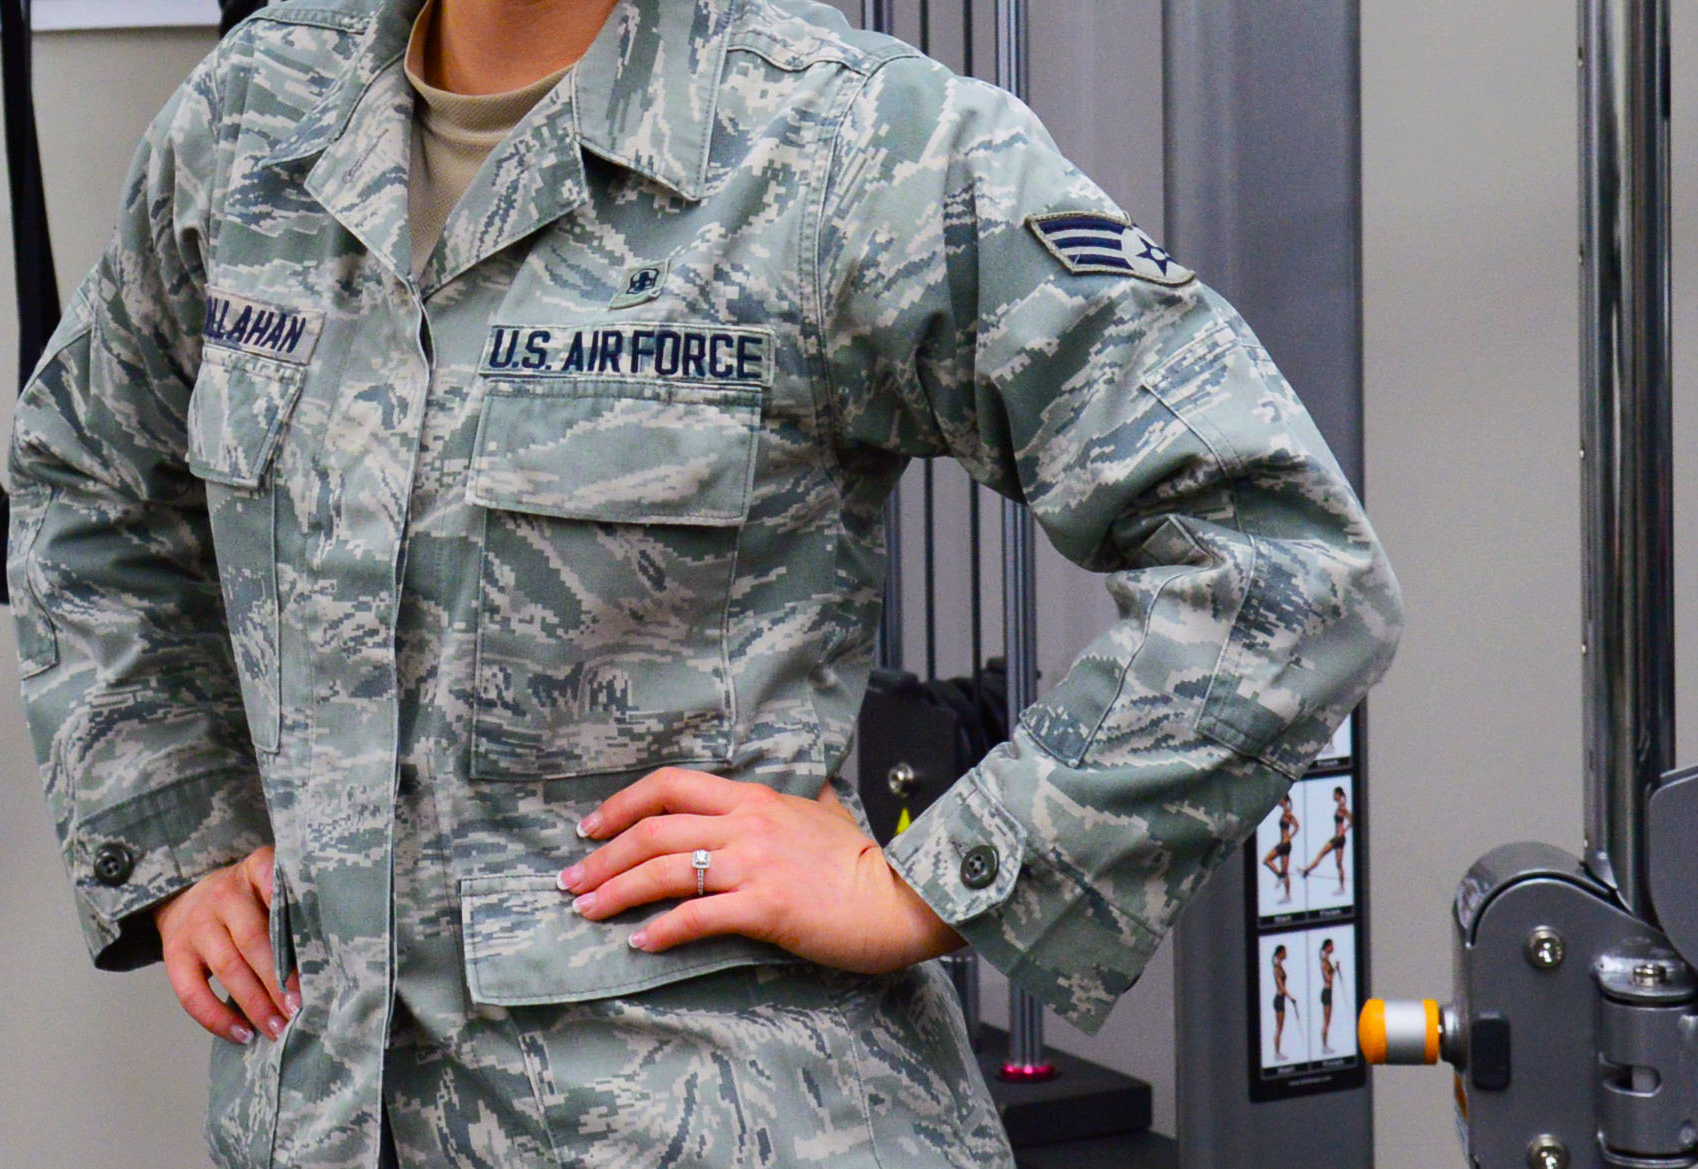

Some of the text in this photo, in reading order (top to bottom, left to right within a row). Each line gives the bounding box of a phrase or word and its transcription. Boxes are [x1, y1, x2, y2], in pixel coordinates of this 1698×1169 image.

[204, 295, 306, 353] LLAHAN
[489, 329, 762, 379] U.S. AIR FORCE
